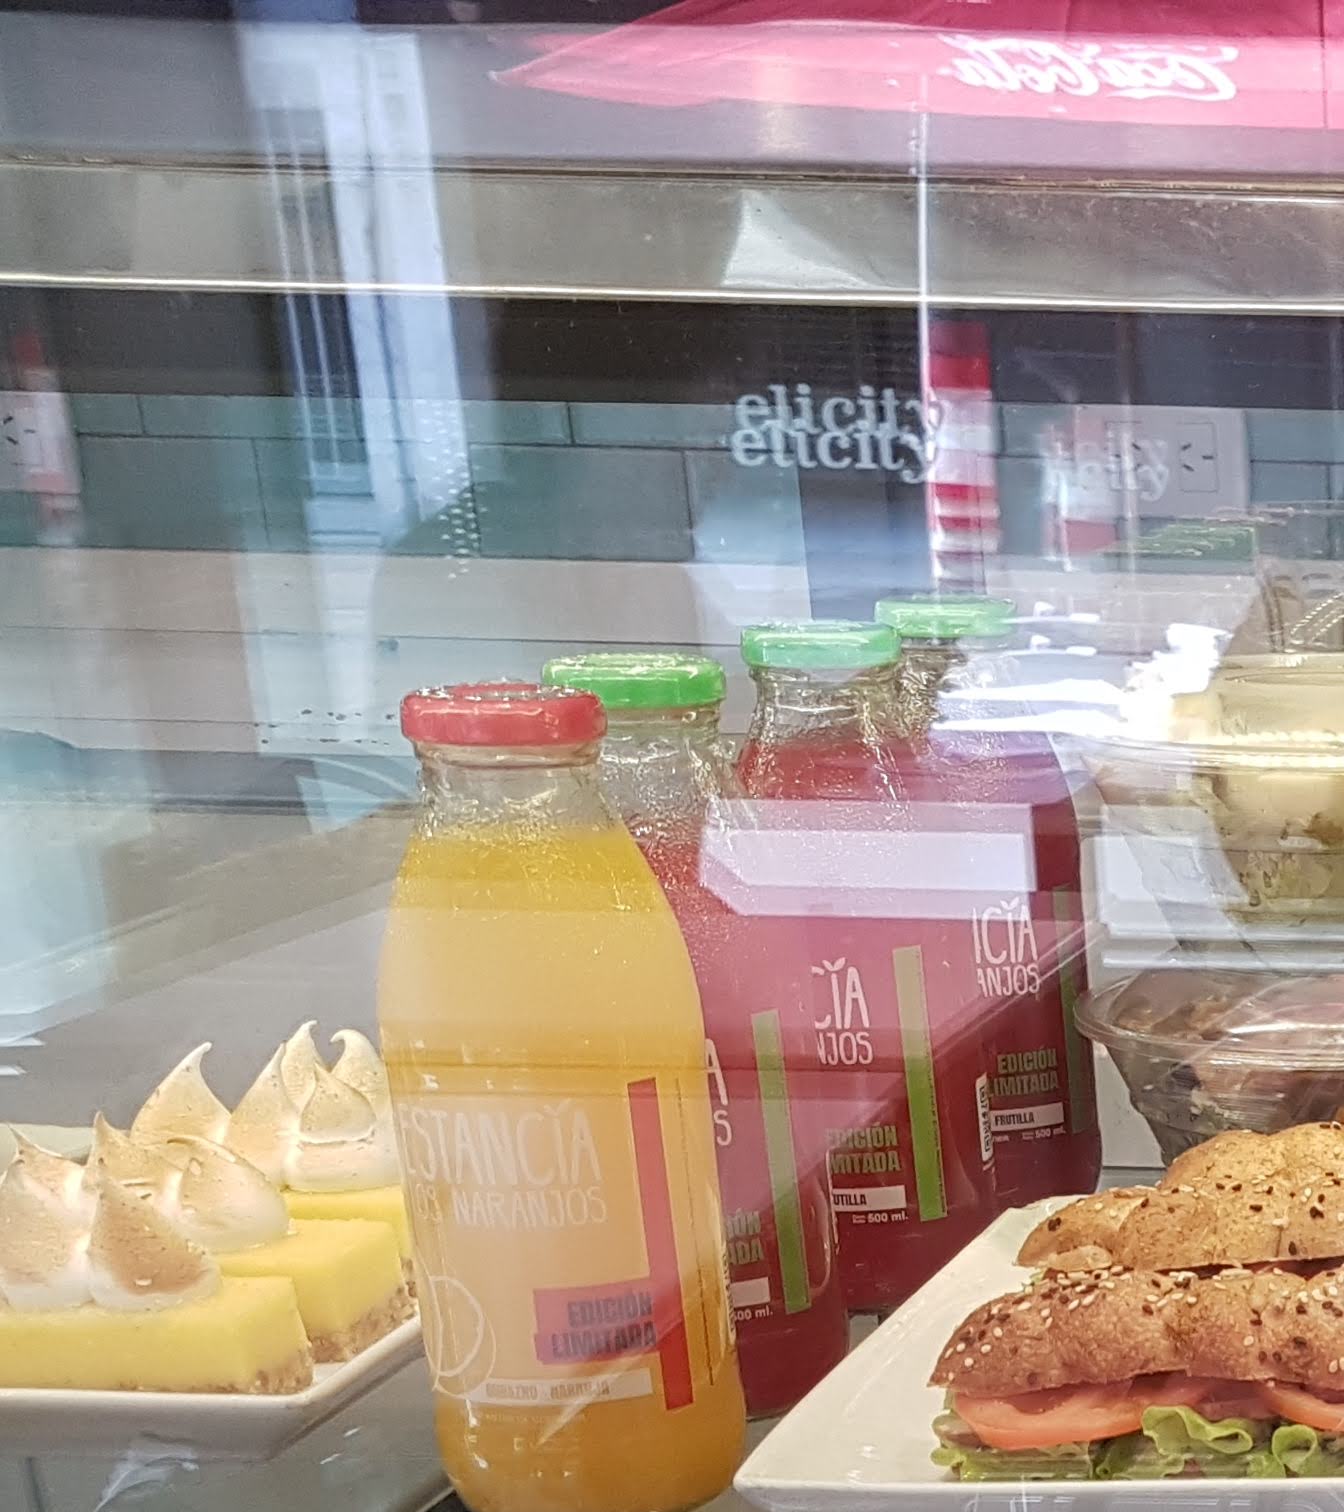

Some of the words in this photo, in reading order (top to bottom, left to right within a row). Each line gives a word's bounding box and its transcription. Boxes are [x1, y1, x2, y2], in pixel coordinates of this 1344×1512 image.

[997, 1049, 1058, 1074] EDICIÓN
[994, 1110, 1035, 1126] FRUTILLA
[830, 1151, 901, 1175] MITADA
[452, 1186, 607, 1231] NARANJOS
[833, 1194, 868, 1207] UTILLA
[867, 1211, 890, 1224] 500
